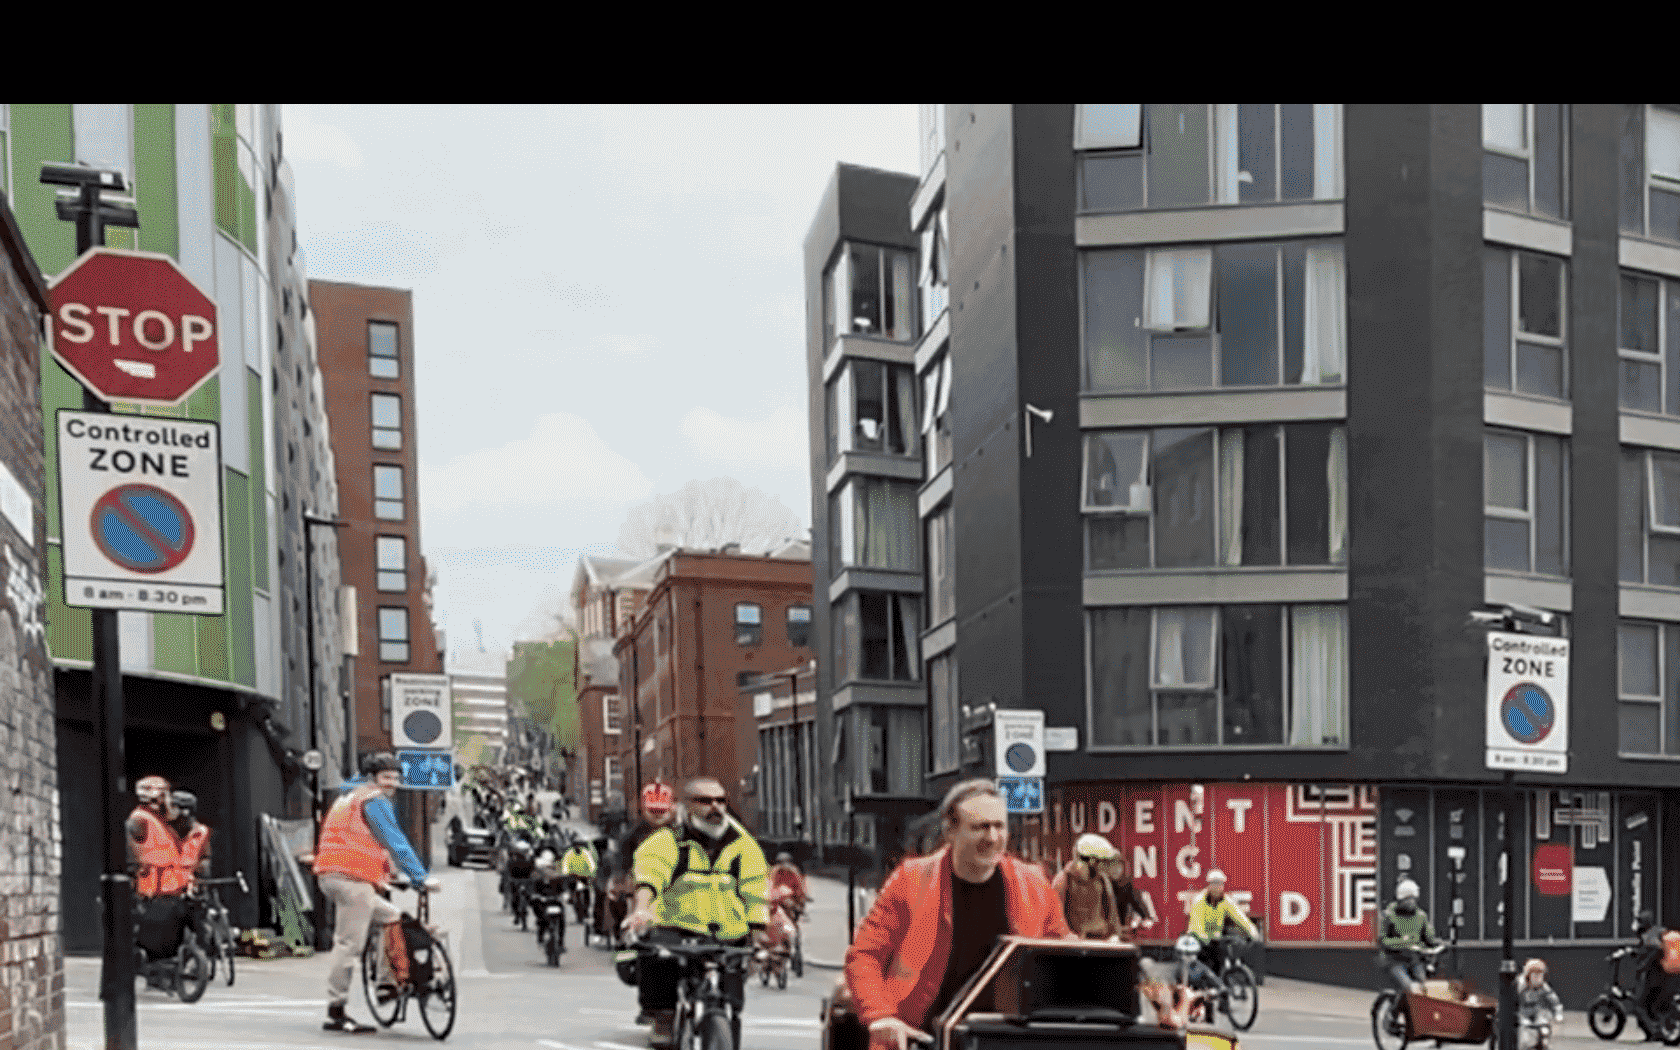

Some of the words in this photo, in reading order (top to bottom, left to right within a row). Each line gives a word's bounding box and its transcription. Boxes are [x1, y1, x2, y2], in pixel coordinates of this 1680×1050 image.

[60, 303, 212, 352] STOP
[66, 419, 210, 448] Controlled
[89, 448, 189, 477] ZONE
[1492, 637, 1567, 657] Controlled
[1502, 657, 1554, 678] ZONE
